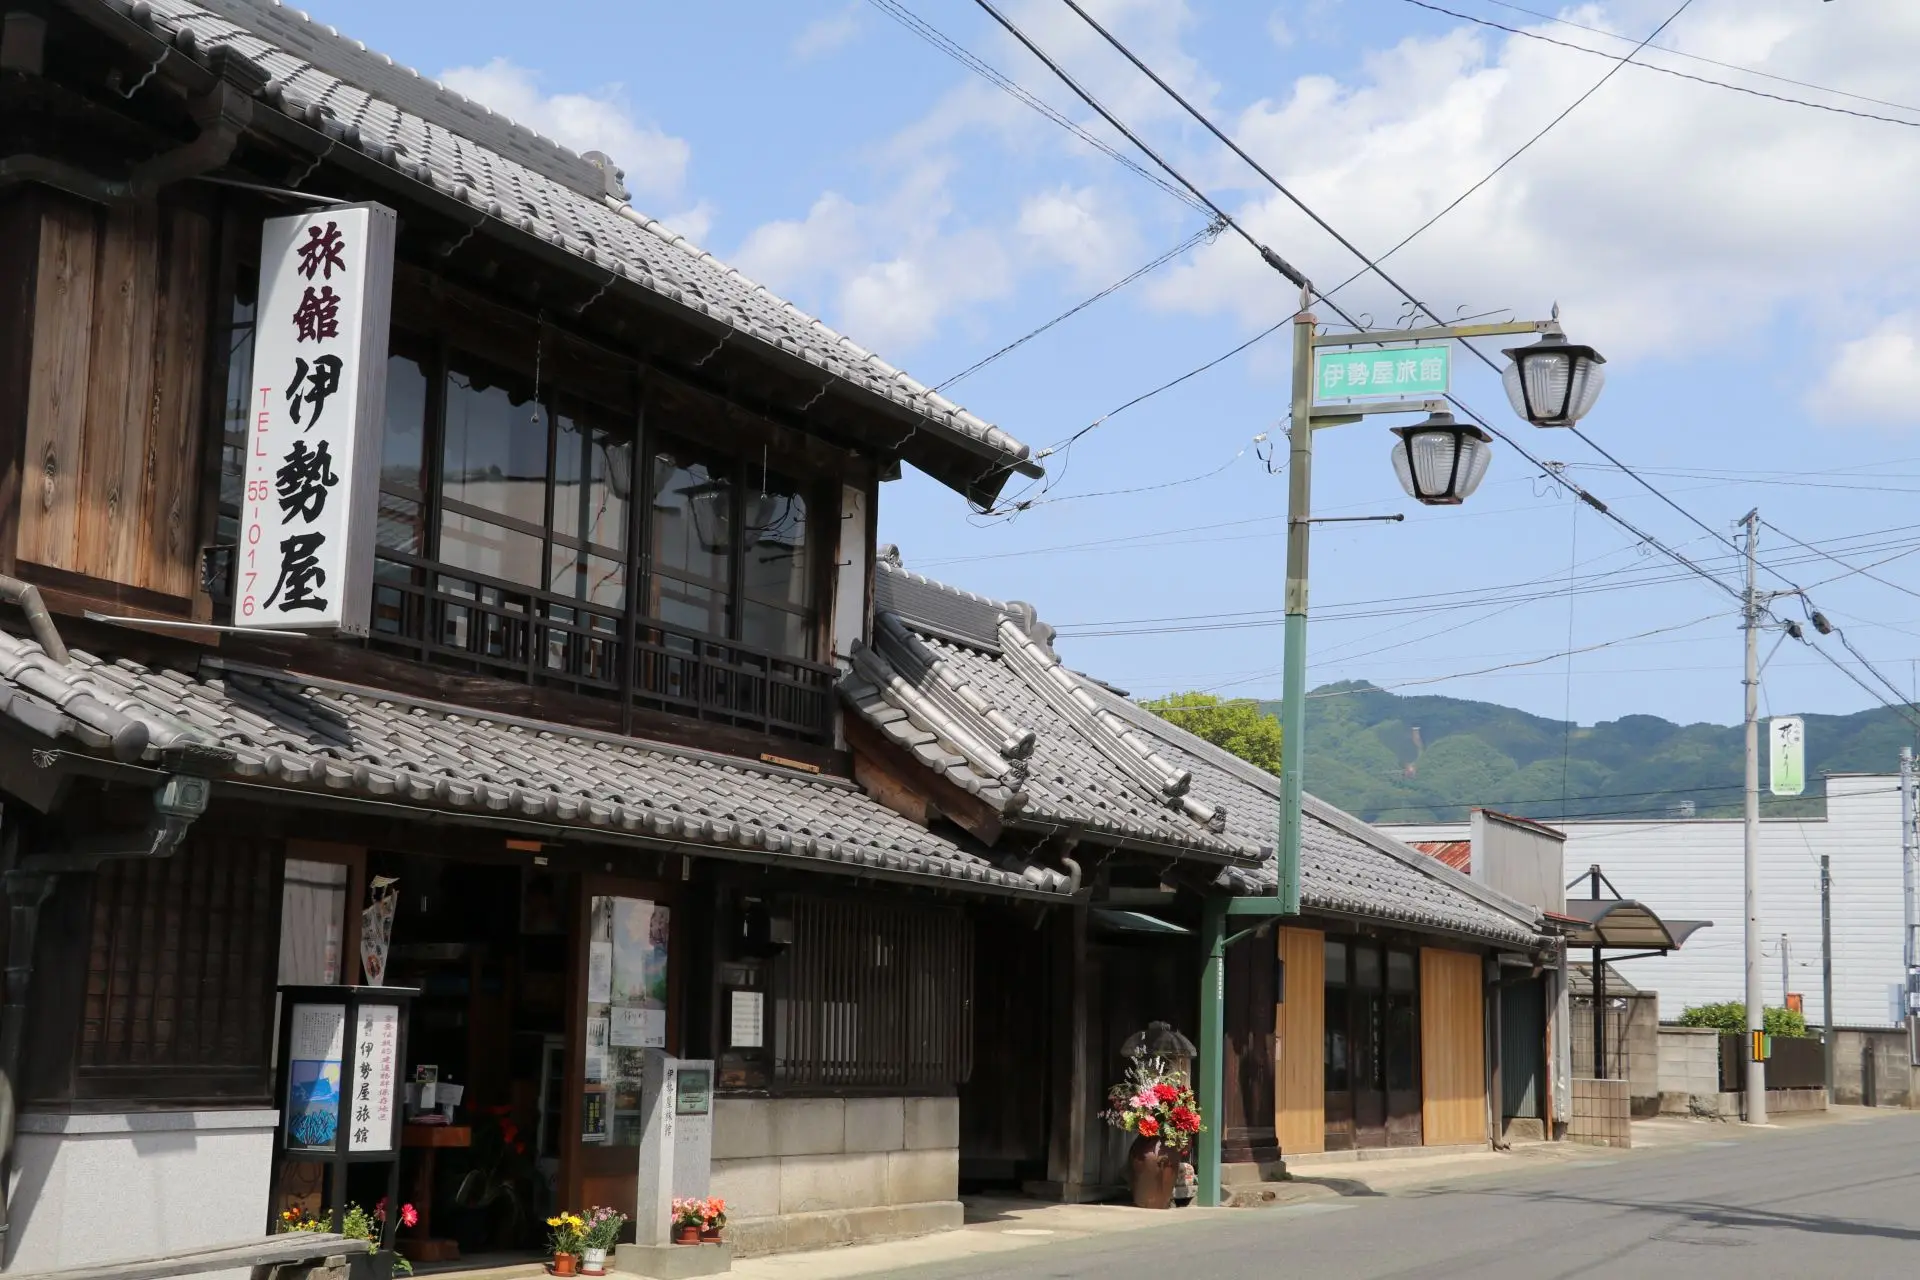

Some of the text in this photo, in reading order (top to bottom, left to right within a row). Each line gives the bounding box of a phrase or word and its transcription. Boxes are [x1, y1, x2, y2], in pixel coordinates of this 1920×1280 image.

[1323, 357, 1443, 388] 伊勢屋旅館
[354, 1041, 374, 1143] 伊勢屋旅館
